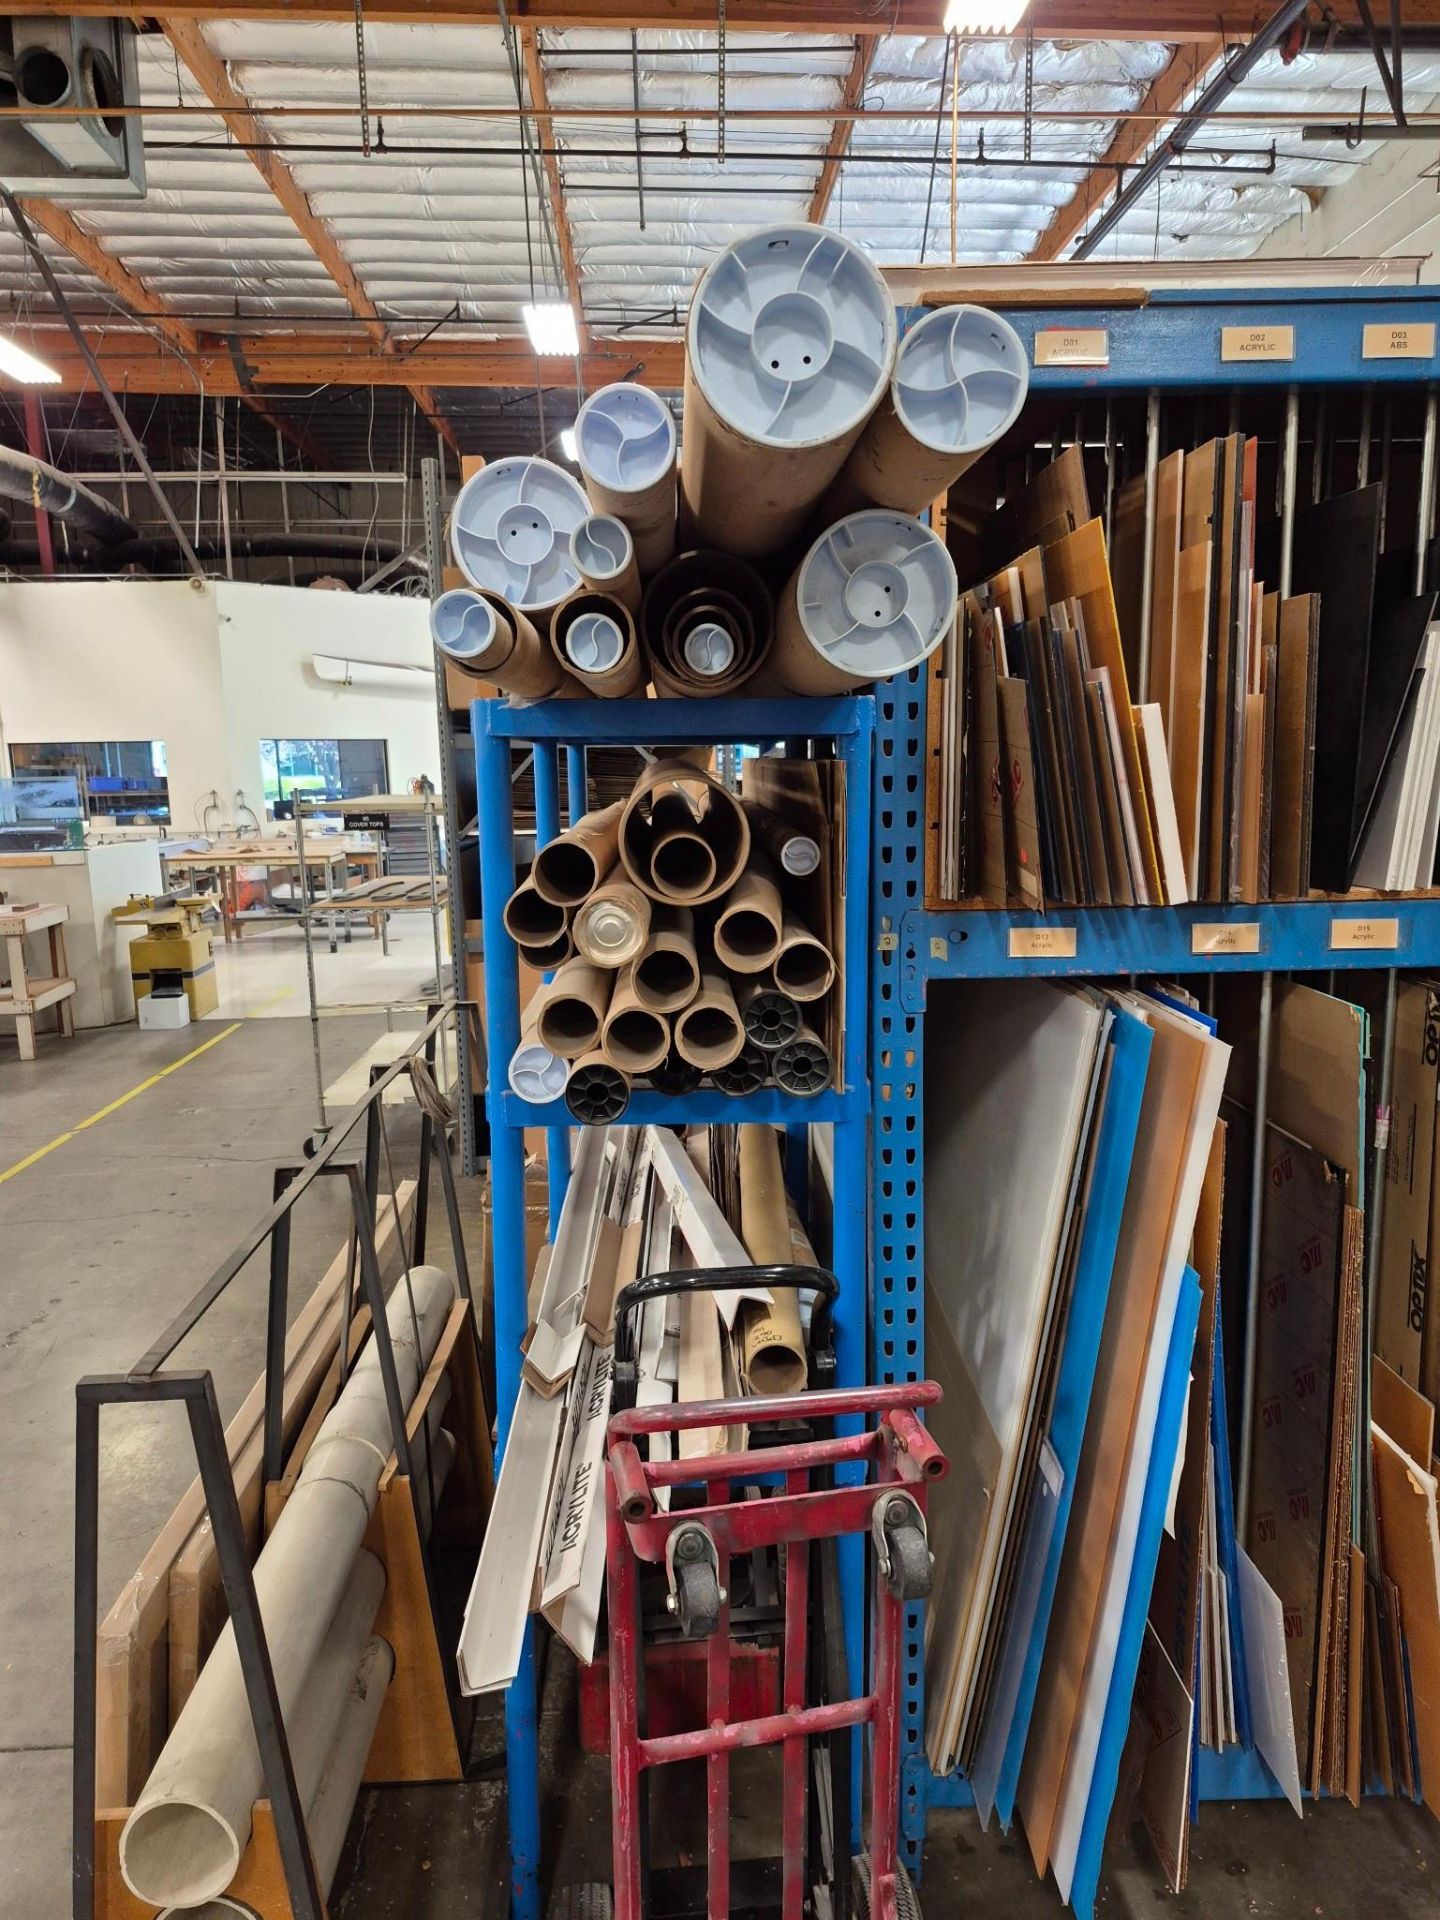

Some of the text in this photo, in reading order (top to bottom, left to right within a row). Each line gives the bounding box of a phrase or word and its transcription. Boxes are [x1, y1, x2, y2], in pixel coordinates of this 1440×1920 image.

[1250, 333, 1266, 342] D02
[1391, 331, 1407, 339] D03
[1063, 338, 1079, 346] D01
[1390, 341, 1409, 349] ABS
[1240, 343, 1276, 352] ACRYLIC
[1410, 1246, 1426, 1333] OPTIX
